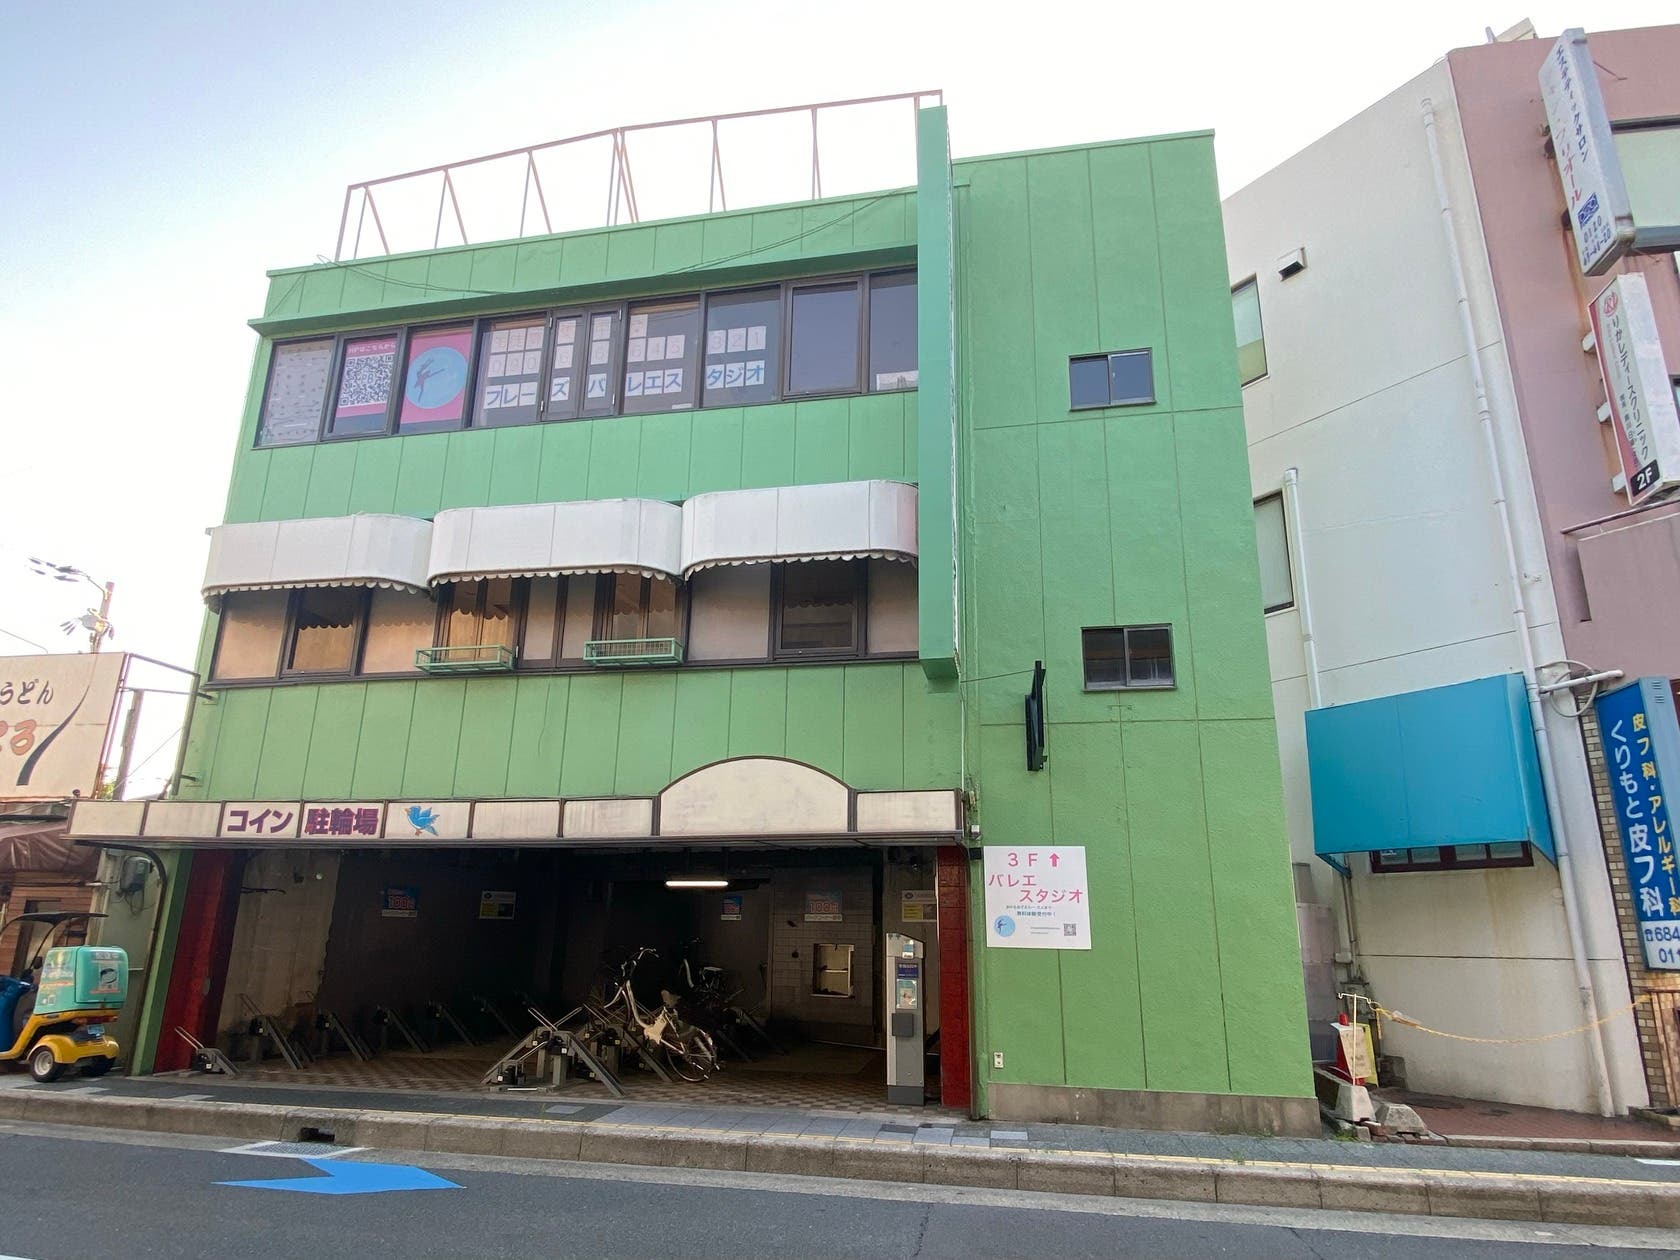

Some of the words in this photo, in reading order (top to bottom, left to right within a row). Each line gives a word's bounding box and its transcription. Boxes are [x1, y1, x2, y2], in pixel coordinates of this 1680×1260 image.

[1637, 466, 1653, 490] 2F
[227, 808, 293, 834] コイン
[304, 808, 379, 835] 駐輪場
[1611, 719, 1664, 917] くりもと皮フ科
[988, 874, 1037, 888] バレエ
[1019, 888, 1084, 904] スタジオ
[1659, 948, 1680, 963] 01
